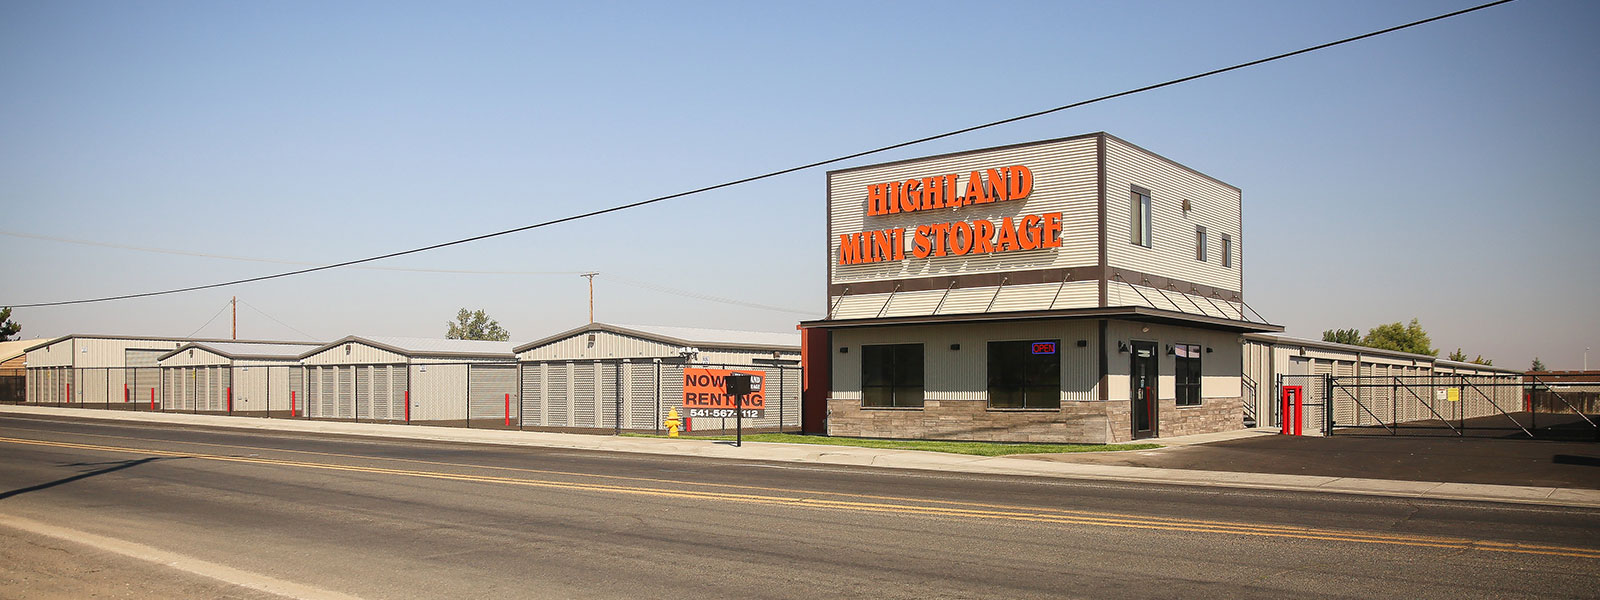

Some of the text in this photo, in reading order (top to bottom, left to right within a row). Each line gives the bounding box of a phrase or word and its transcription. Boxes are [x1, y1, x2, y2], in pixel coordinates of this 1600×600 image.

[867, 165, 1034, 217] HIGHLAND
[839, 211, 1063, 265] MINI STORAGE
[1033, 343, 1055, 353] OPEN
[685, 374, 726, 388] NOW
[685, 392, 763, 407] RENTING
[690, 409, 758, 418] 541-567-112
